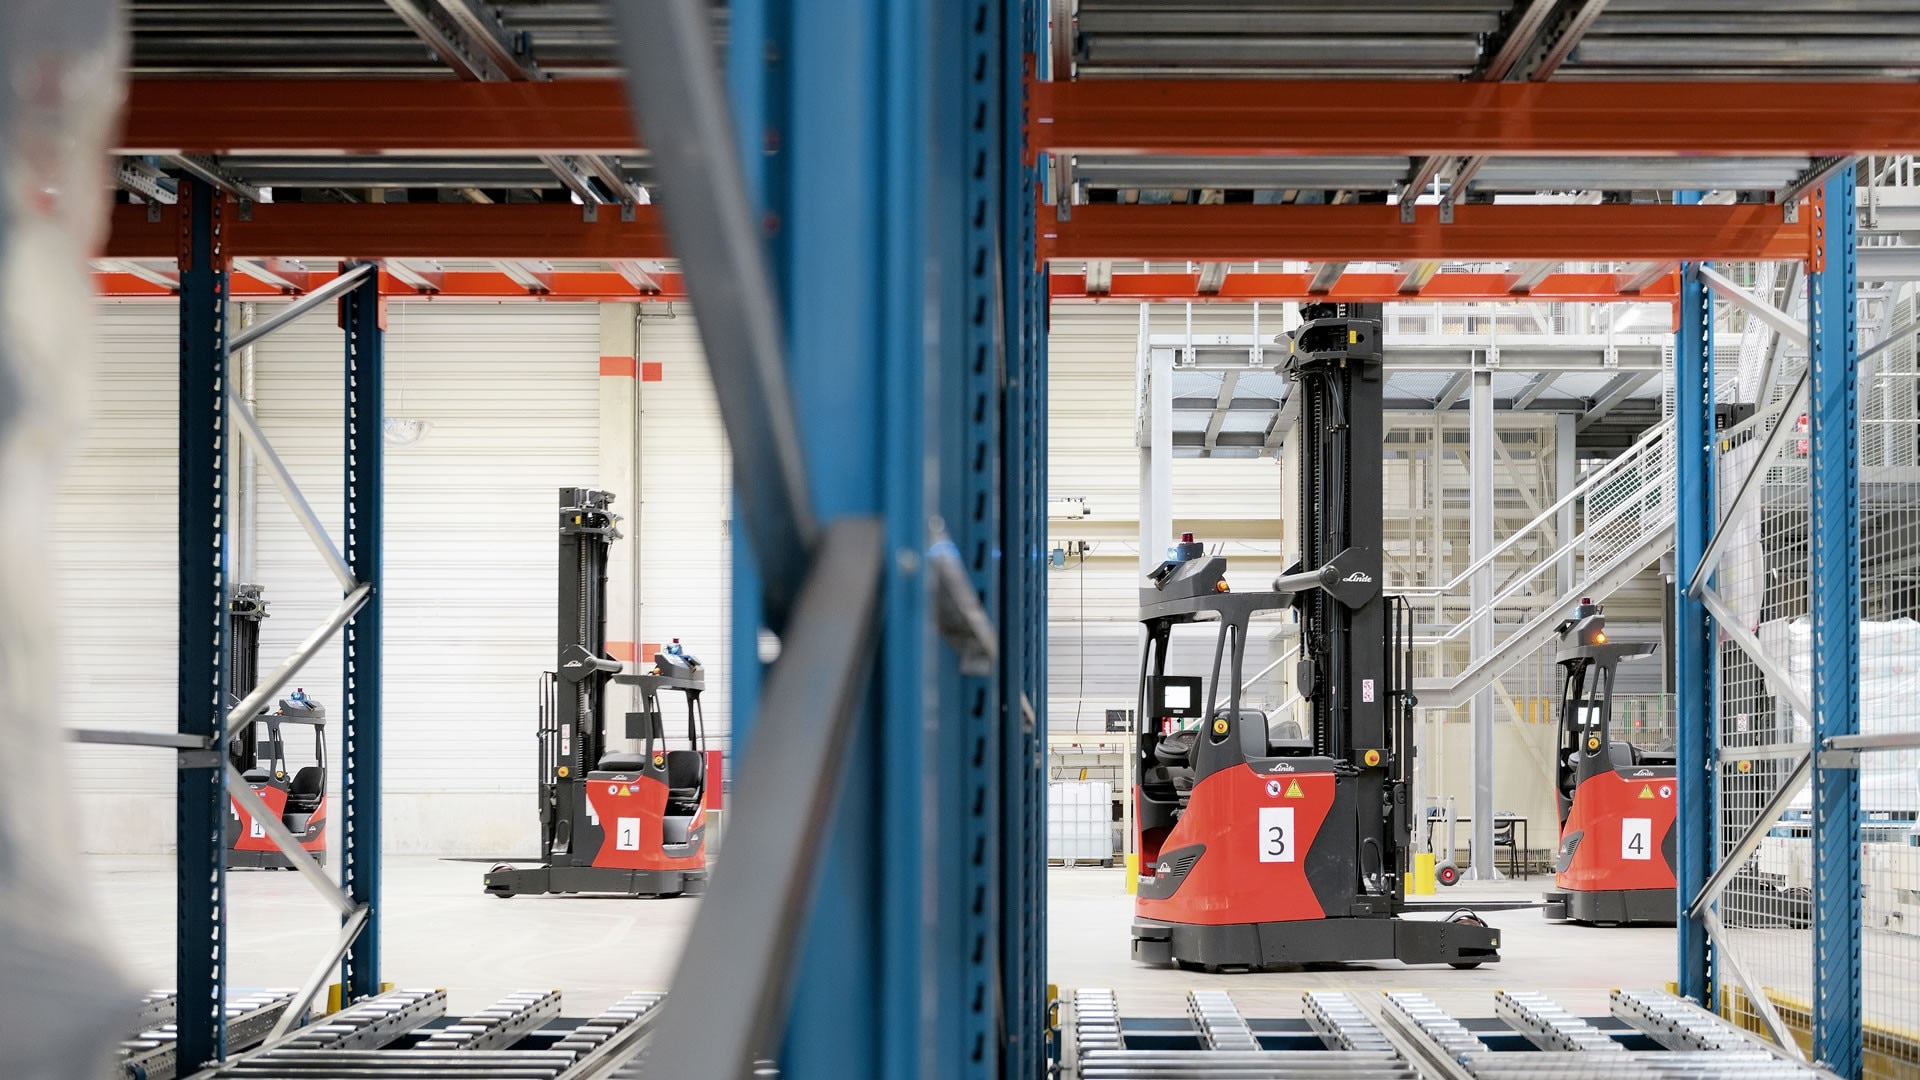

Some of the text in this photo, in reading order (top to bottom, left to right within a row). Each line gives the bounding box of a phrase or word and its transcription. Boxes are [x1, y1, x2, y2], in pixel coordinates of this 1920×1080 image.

[1342, 571, 1372, 583] Linde
[1269, 762, 1295, 772] Linde
[255, 822, 262, 836] 1
[623, 829, 633, 847] 1
[1268, 826, 1285, 856] 3
[1628, 832, 1644, 855] 4
